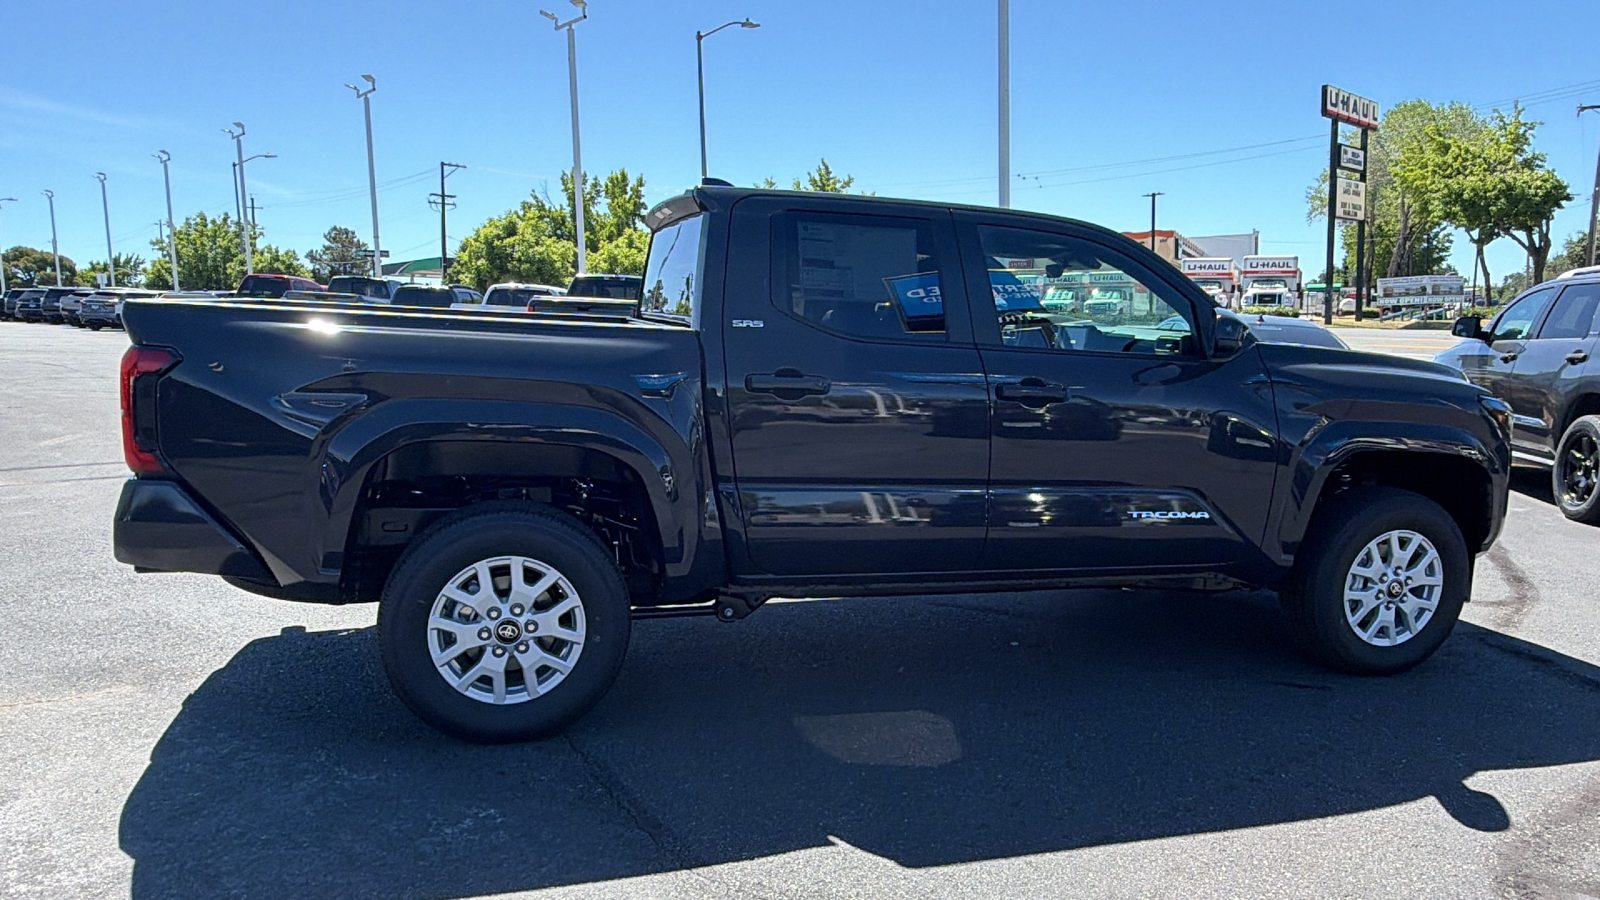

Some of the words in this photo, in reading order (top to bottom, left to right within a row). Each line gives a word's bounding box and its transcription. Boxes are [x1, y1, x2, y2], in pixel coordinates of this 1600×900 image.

[1187, 263, 1228, 271] U-HAUL
[1249, 261, 1293, 269] U-HAUL
[1127, 511, 1210, 519] TACOMA
